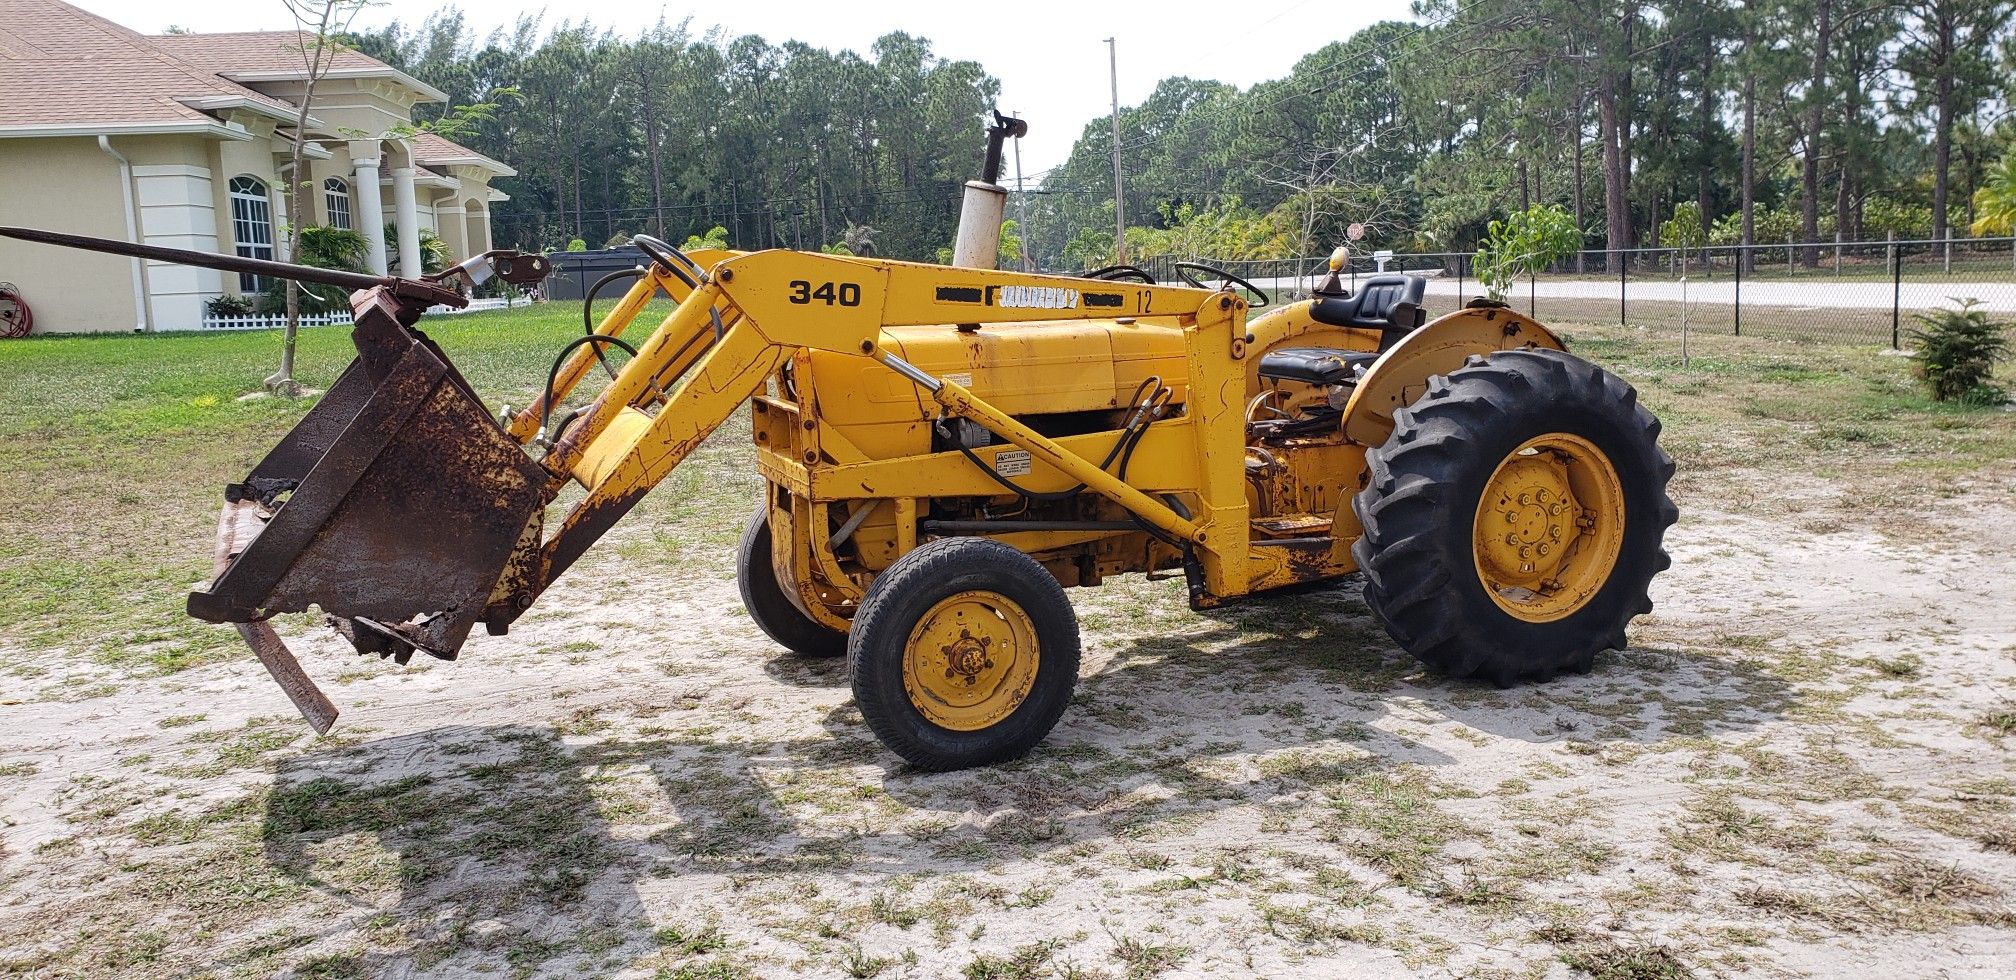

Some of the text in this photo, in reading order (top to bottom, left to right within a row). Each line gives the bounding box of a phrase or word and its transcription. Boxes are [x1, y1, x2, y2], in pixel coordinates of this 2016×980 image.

[789, 280, 861, 307] 340
[1136, 289, 1152, 314] 12
[1003, 452, 1029, 460] CAUTION
